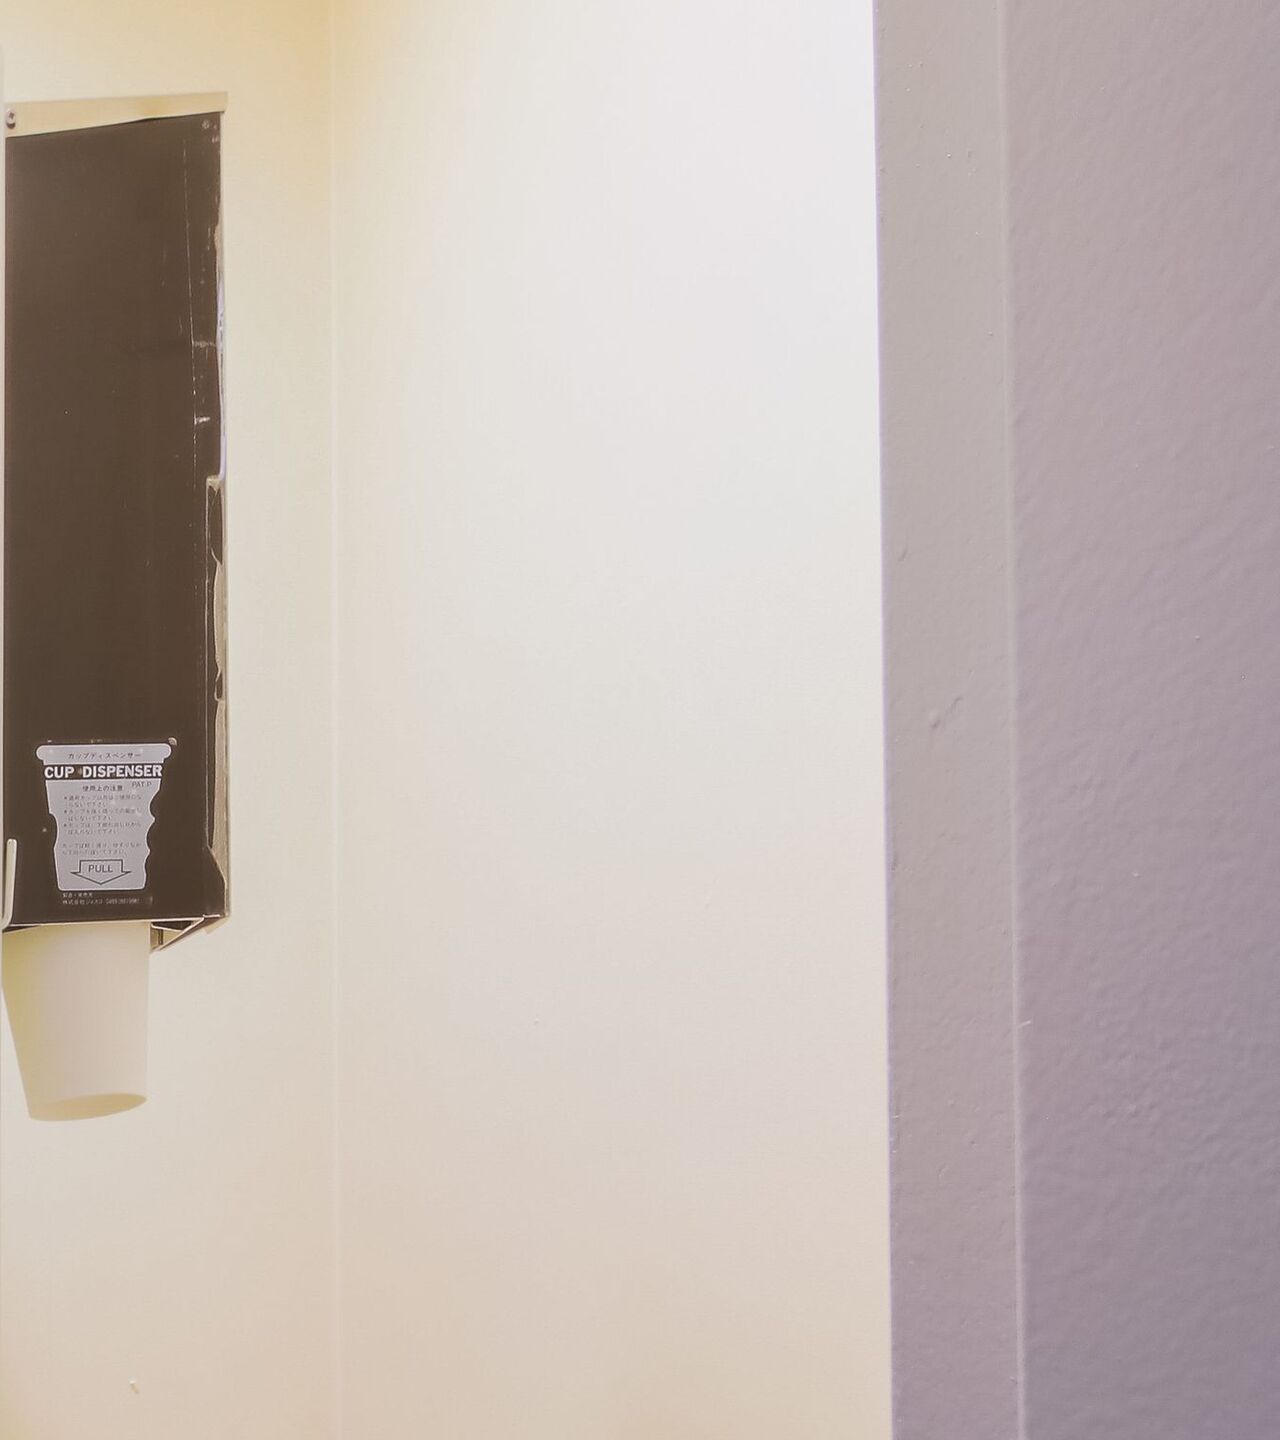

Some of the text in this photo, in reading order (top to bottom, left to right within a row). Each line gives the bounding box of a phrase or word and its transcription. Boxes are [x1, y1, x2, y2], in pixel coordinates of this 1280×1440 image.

[44, 764, 163, 779] CUP DISPENSER
[88, 864, 113, 873] PULL
